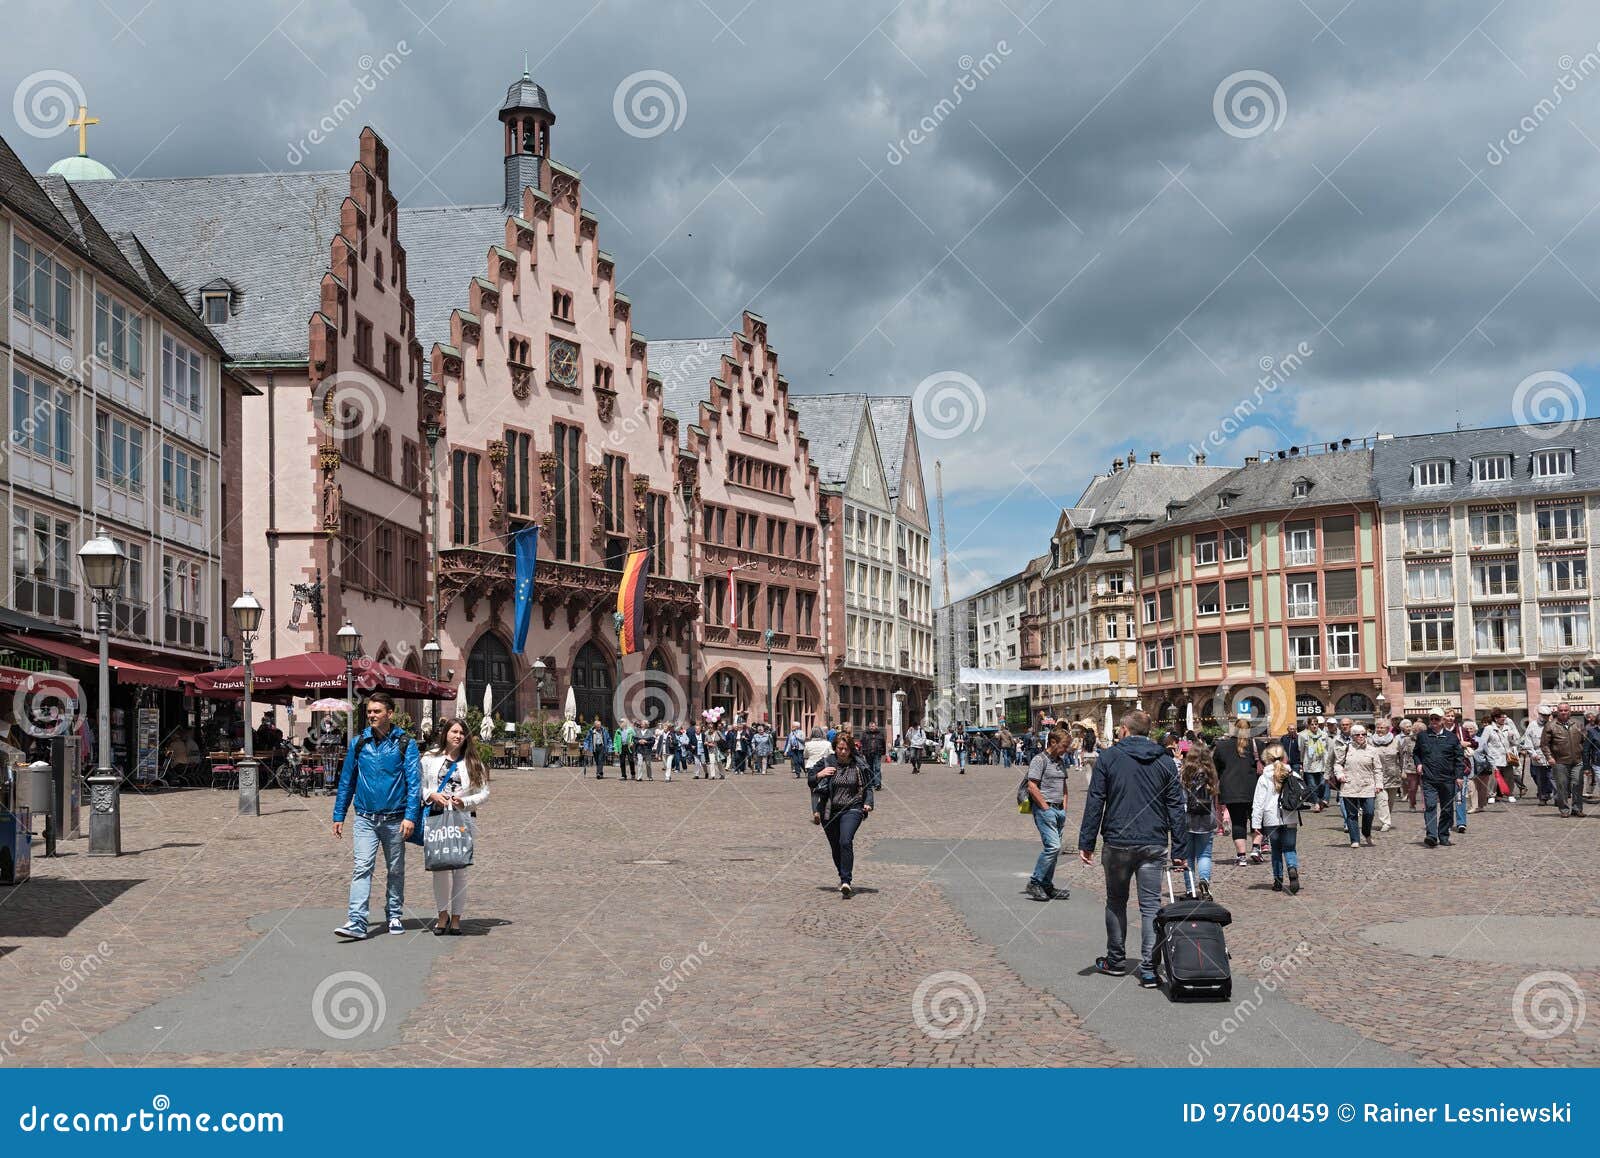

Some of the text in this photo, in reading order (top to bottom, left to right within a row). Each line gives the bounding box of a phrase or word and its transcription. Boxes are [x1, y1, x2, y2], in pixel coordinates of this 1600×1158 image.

[212, 681, 245, 689] LIMPUR
[1239, 703, 1250, 713] U
[1296, 706, 1322, 714] EISS
